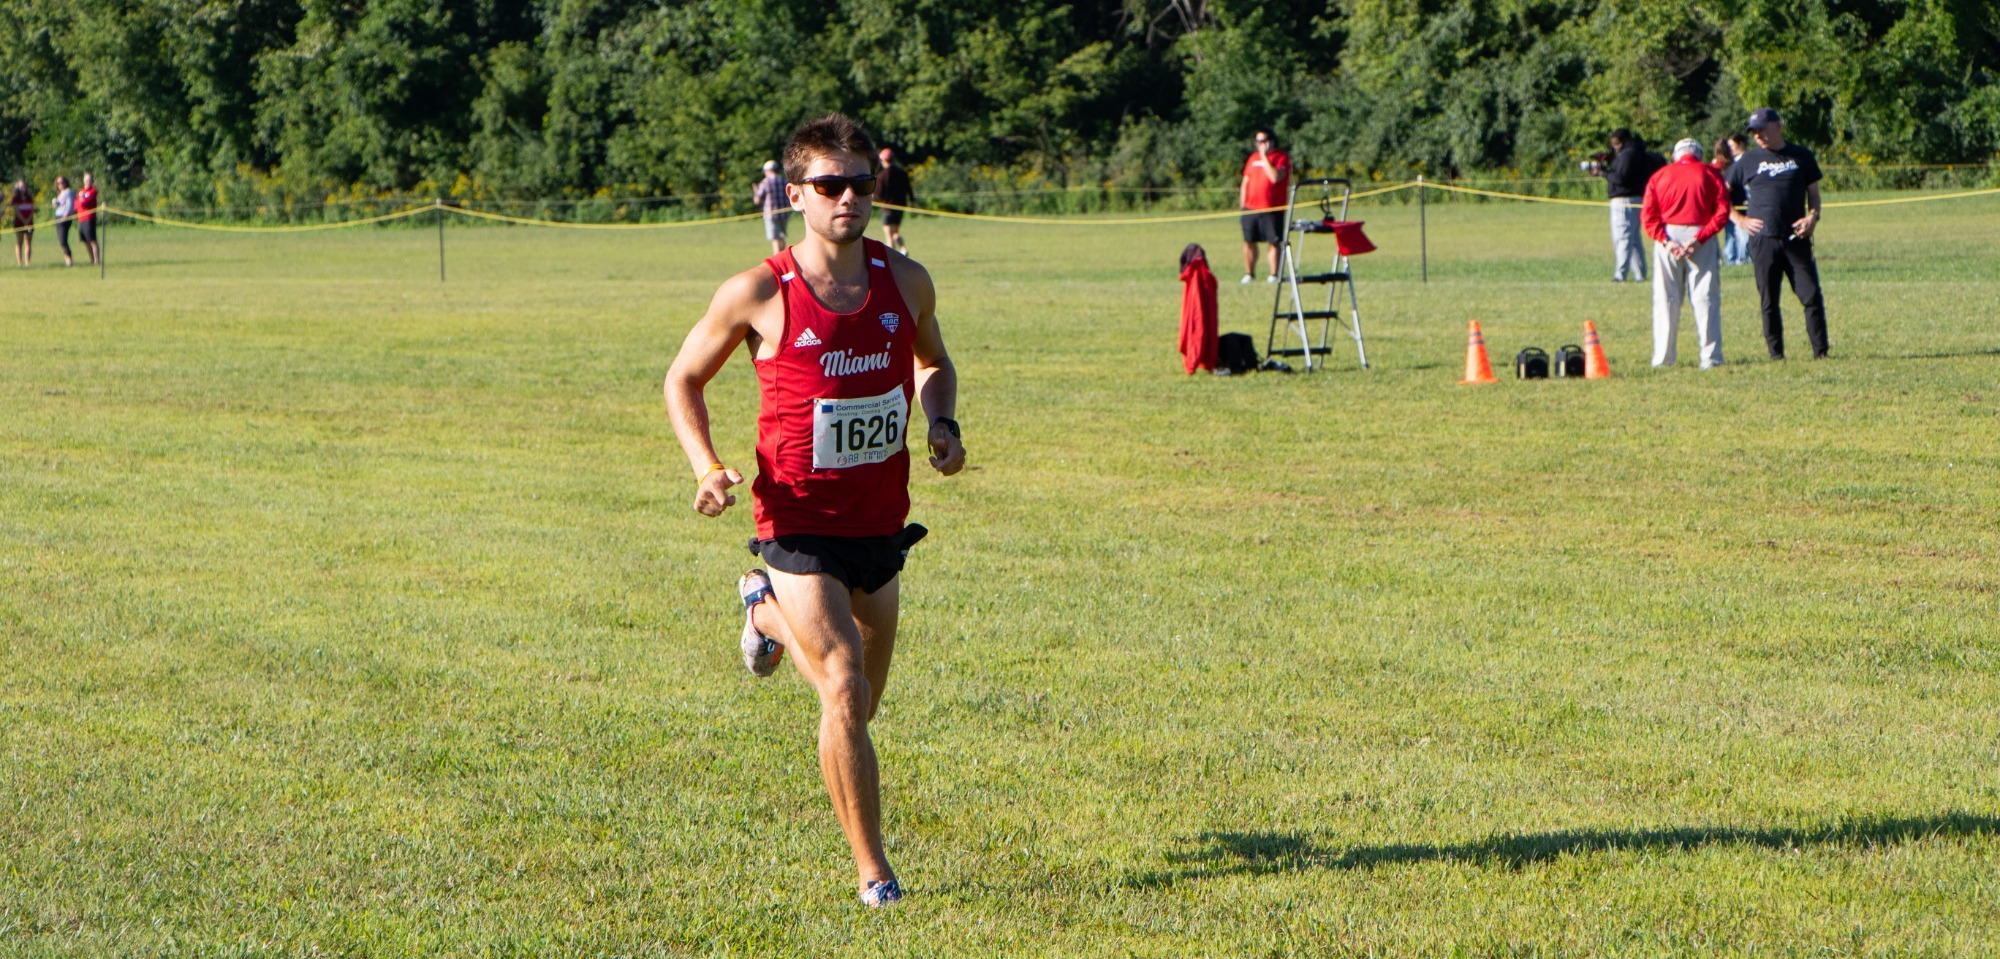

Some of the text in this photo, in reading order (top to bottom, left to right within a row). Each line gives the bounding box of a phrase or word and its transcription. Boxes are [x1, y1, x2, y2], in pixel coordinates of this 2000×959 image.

[794, 339, 822, 347] adidas
[819, 341, 892, 378] Miami
[835, 401, 881, 411] Commercial
[830, 409, 898, 453] 1626
